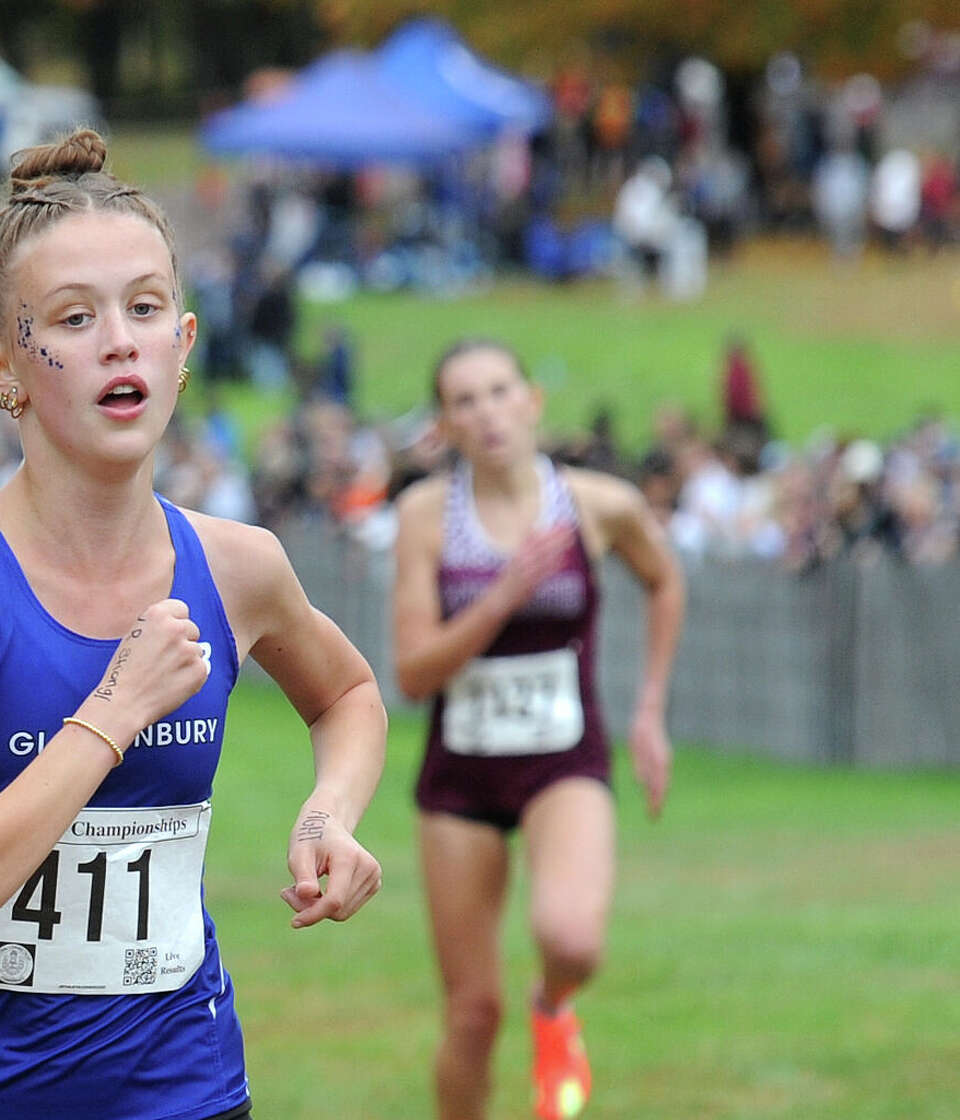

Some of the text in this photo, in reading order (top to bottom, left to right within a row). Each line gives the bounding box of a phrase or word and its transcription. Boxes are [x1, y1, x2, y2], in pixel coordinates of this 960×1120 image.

[8, 718, 218, 756] GLNBURY
[70, 817, 188, 840] Championships
[297, 809, 331, 842] FIGHT
[10, 848, 152, 942] 411
[160, 965, 186, 976] Results
[164, 952, 181, 962] Live
